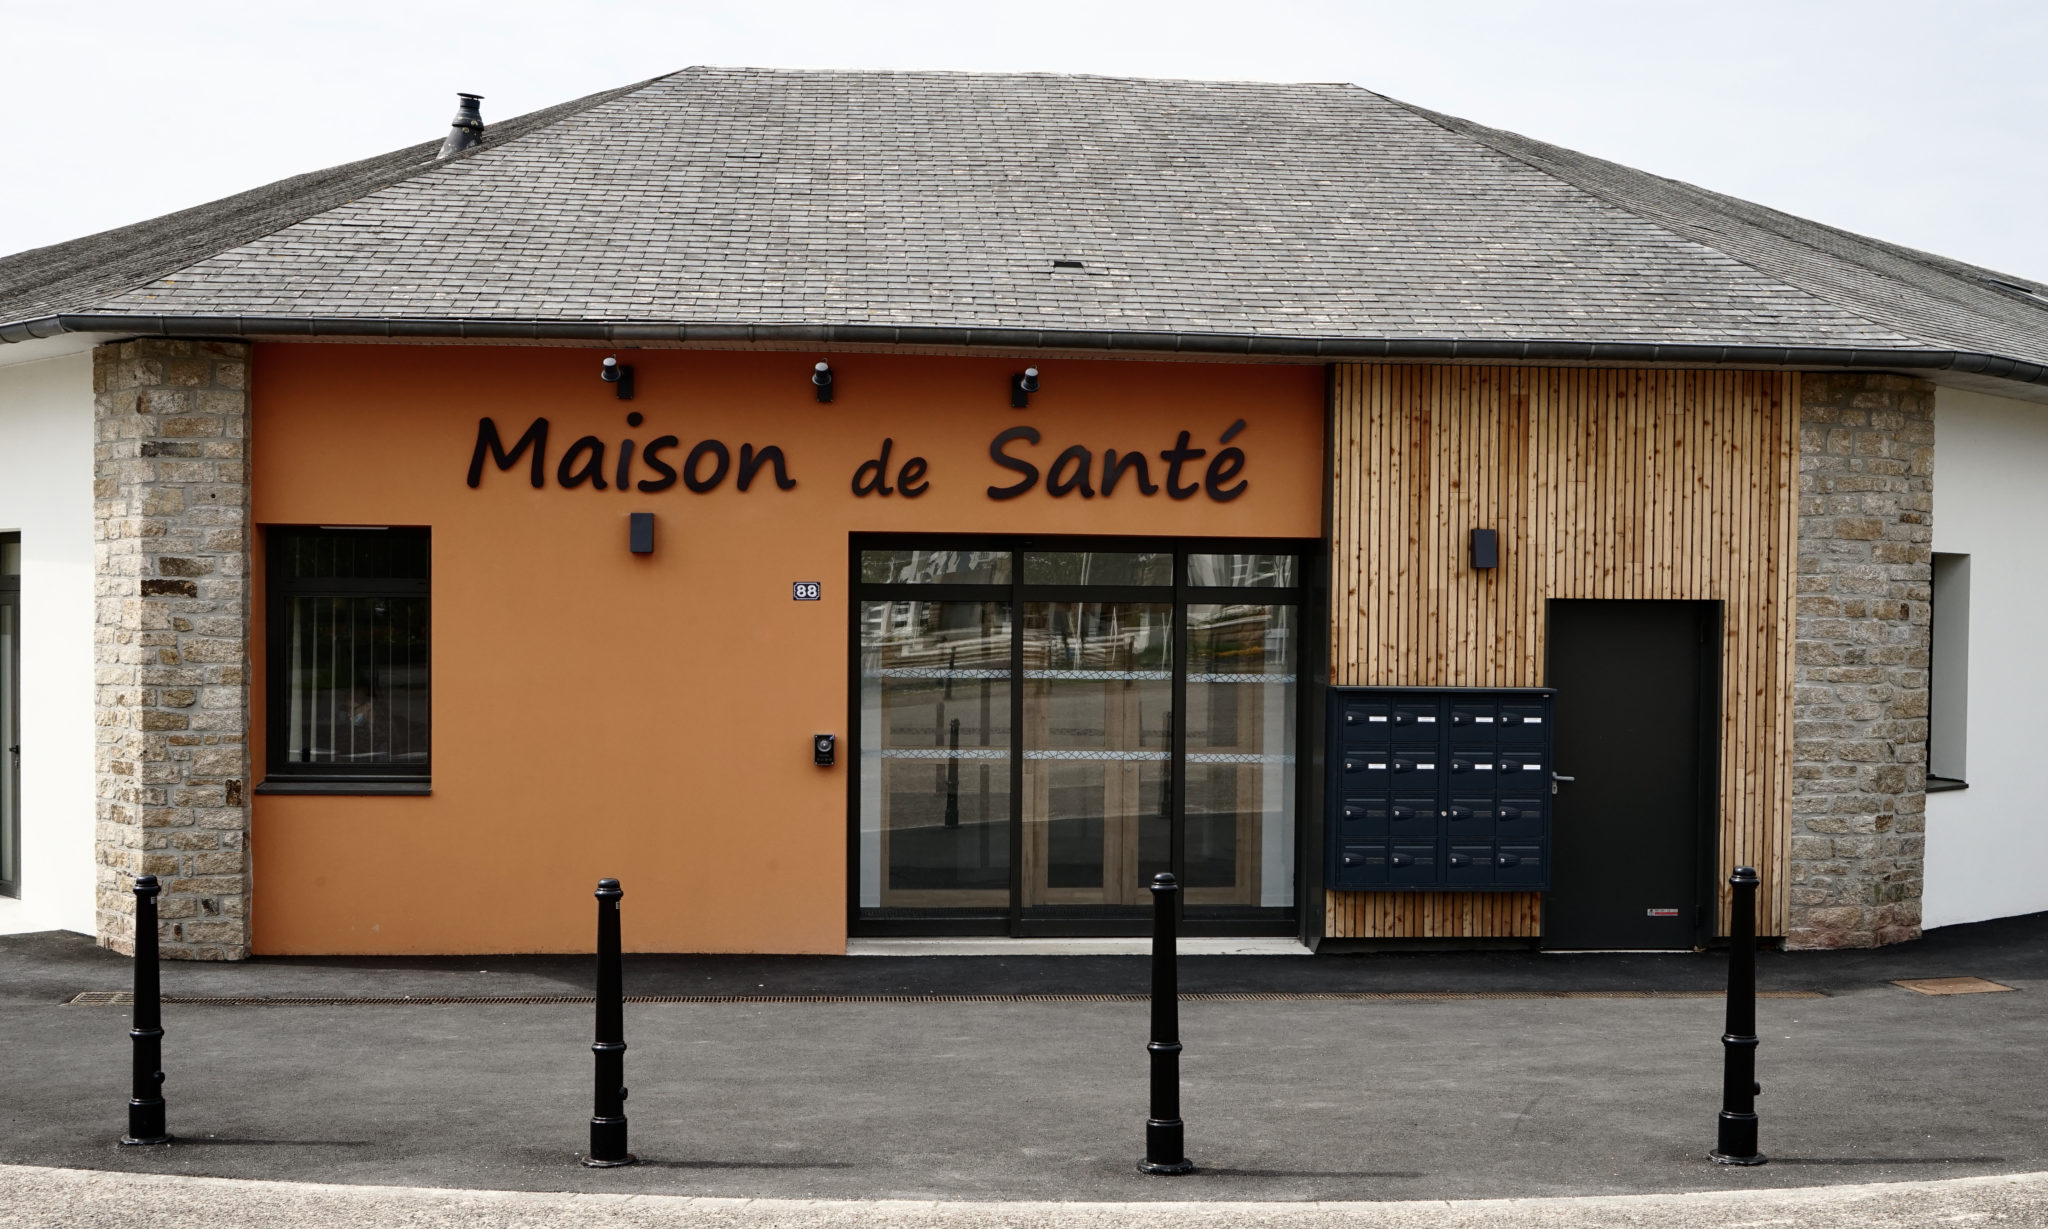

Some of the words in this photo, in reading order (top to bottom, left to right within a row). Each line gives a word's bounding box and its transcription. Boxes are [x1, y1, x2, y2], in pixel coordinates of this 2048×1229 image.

[467, 412, 796, 493] Maison
[851, 437, 929, 498] de
[987, 418, 1248, 502] Santé
[796, 584, 818, 598] 88
